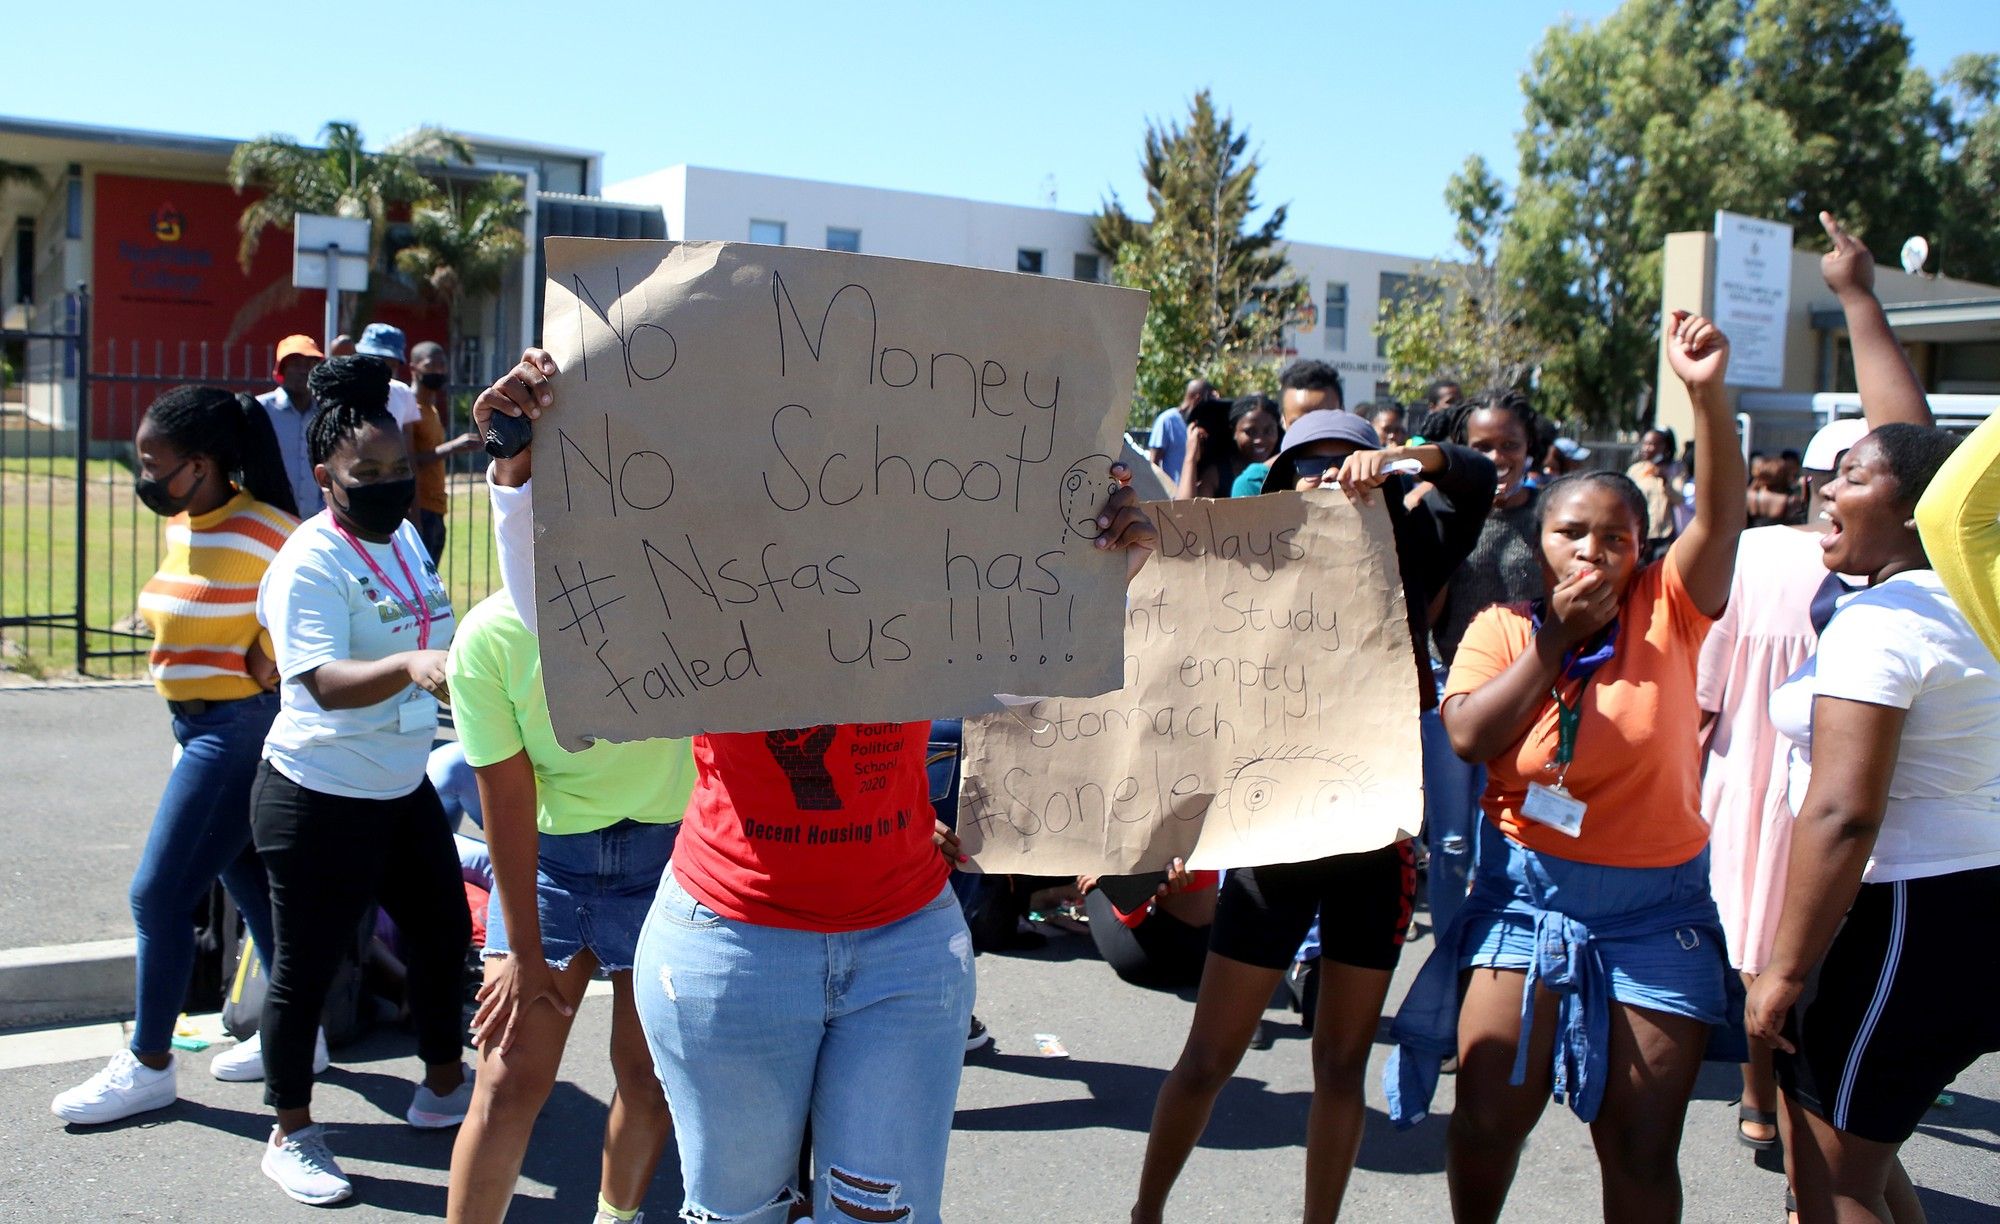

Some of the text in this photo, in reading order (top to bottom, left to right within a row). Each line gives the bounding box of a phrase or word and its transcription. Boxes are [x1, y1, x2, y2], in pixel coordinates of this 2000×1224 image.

[572, 266, 1061, 464] No Money
[557, 412, 675, 517] No
[945, 528, 1066, 597] has
[1155, 504, 1306, 583] Delays
[827, 613, 911, 669] us
[1213, 590, 1341, 652] Study
[1178, 652, 1308, 719] empty
[850, 737, 905, 758] Political
[855, 722, 903, 738] Fourth
[1029, 700, 1237, 749] Stomach
[854, 758, 898, 776] School
[858, 775, 888, 794] 2020
[743, 815, 801, 844] Decent
[807, 820, 873, 845] Housing
